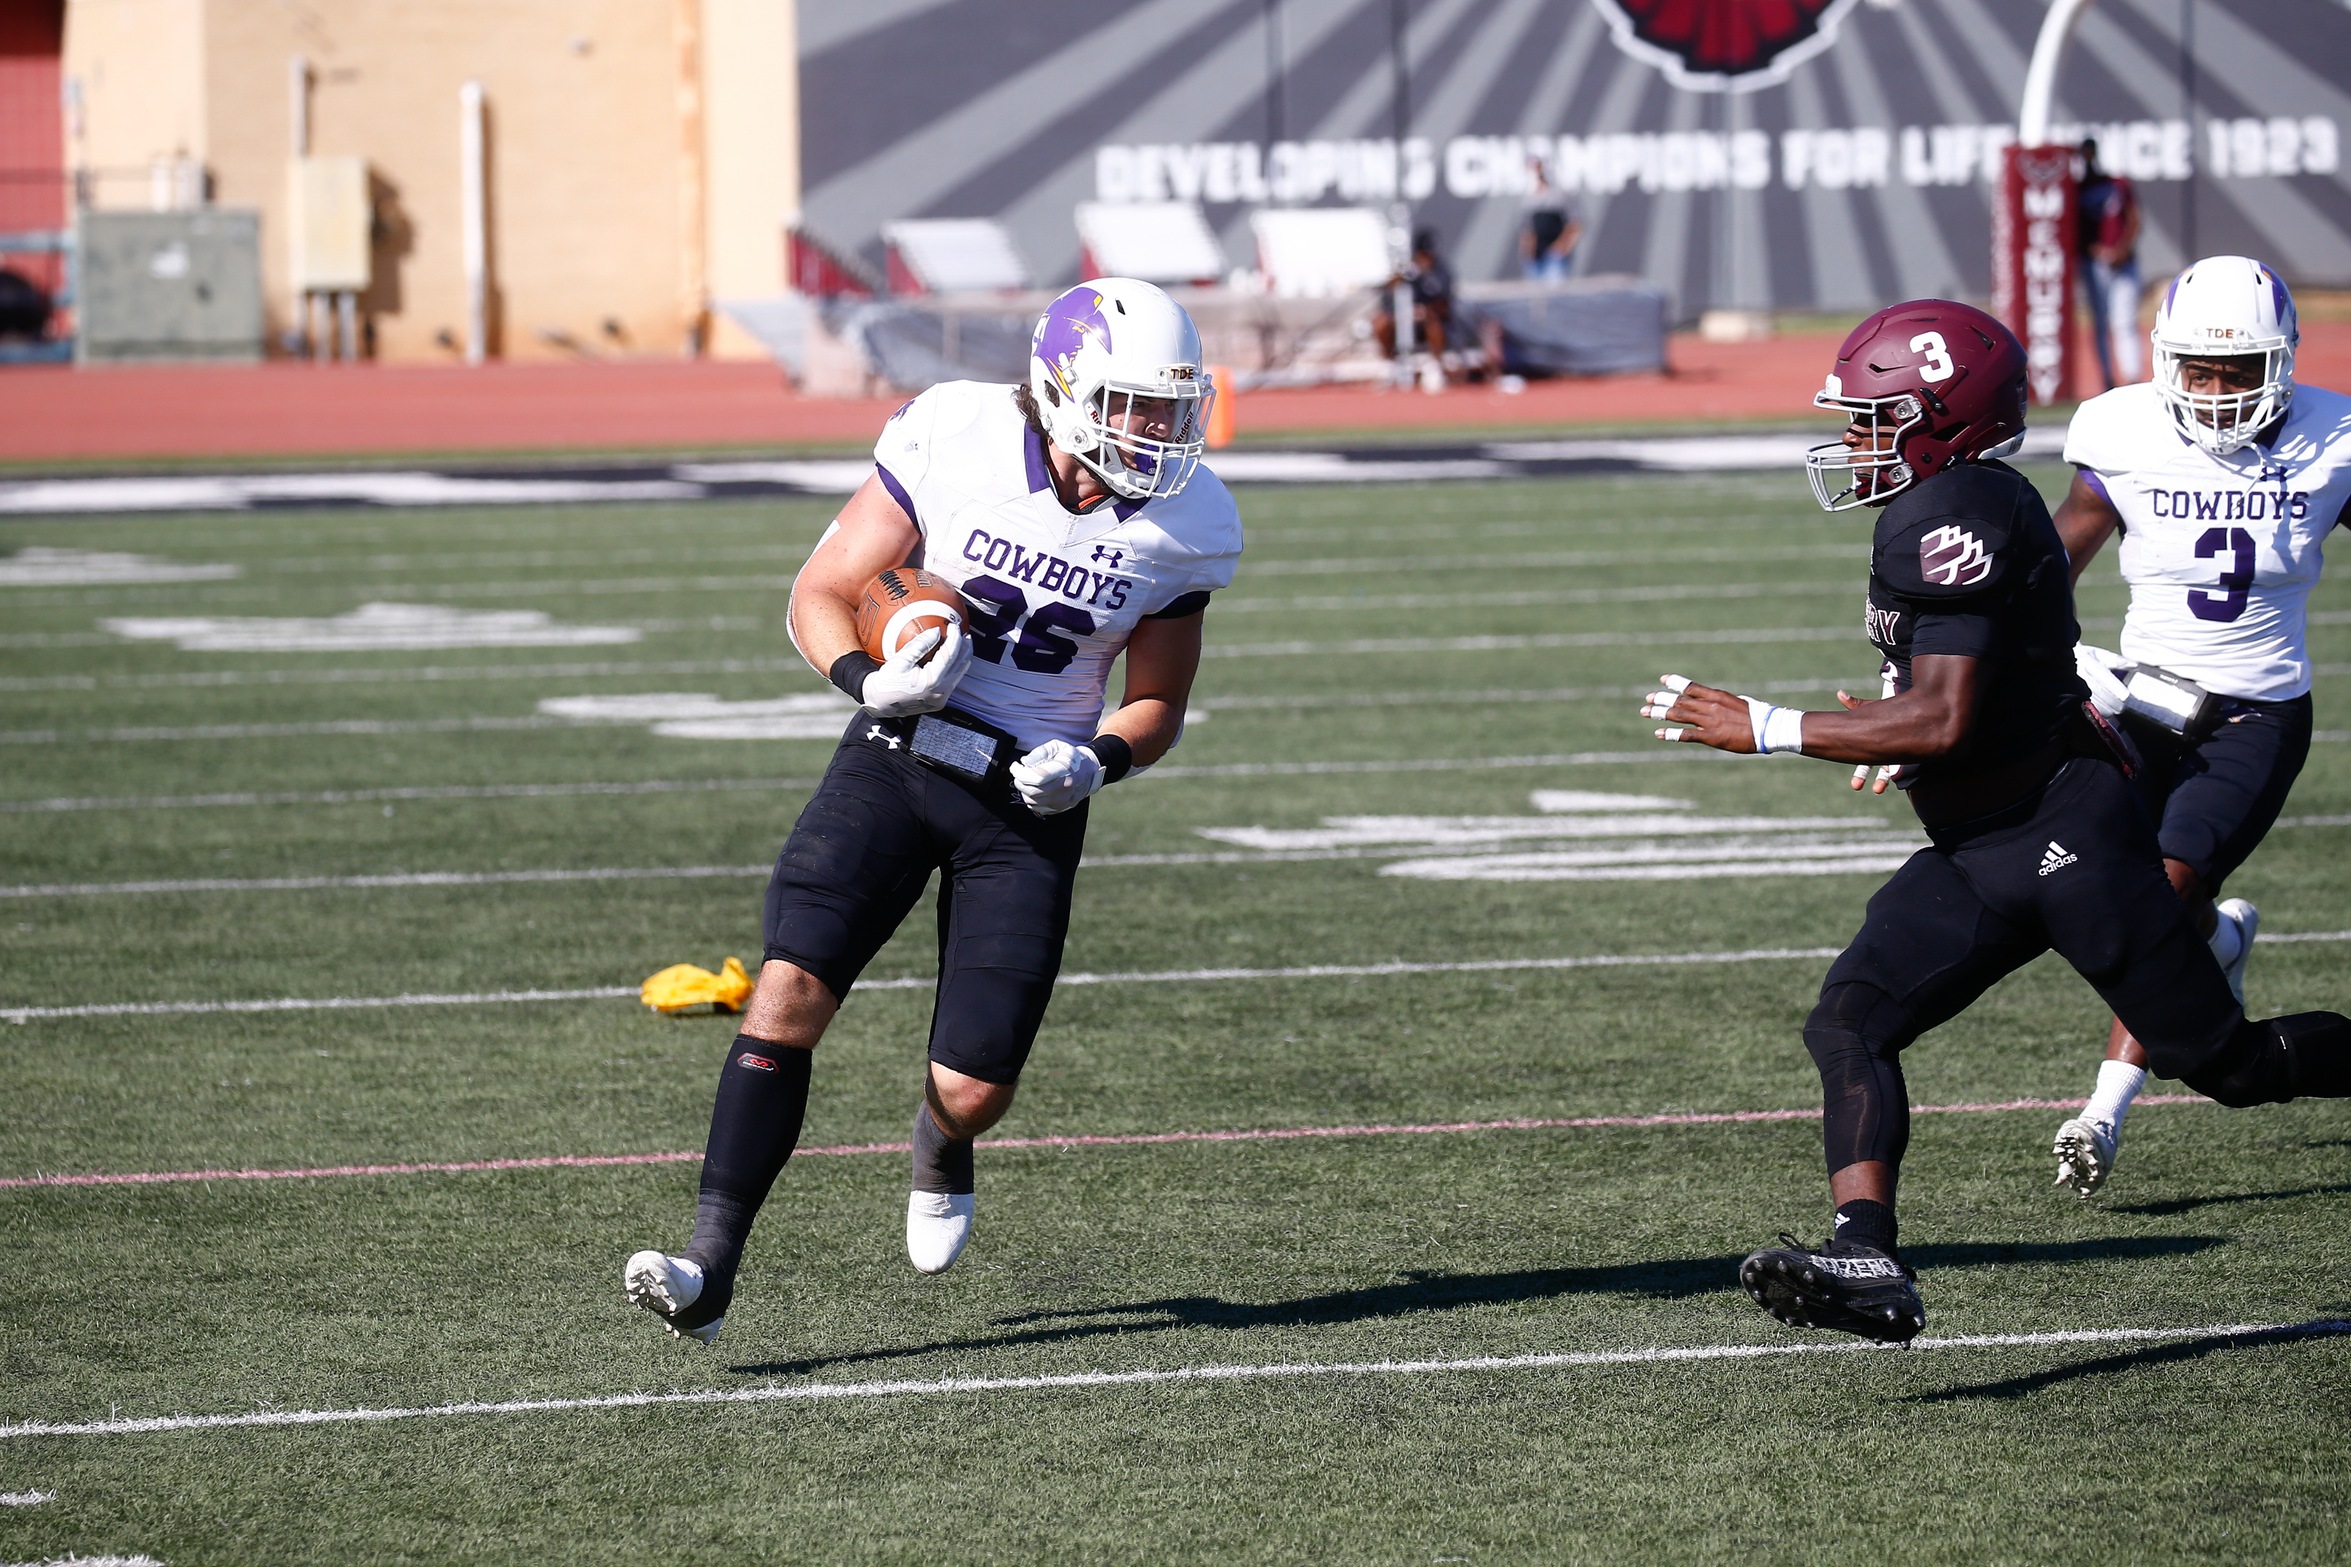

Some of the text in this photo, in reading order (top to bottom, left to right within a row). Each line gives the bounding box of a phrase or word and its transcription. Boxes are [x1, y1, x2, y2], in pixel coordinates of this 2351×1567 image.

[1780, 127, 1892, 188] FOR
[2207, 115, 2341, 179] 1923
[2206, 328, 2235, 339] TDE
[1170, 367, 1195, 380] TDE
[1909, 331, 1955, 384] 3
[2153, 489, 2310, 521] COWBOYS
[962, 528, 1133, 611] COWBOYS
[2186, 527, 2257, 623] 3
[2038, 853, 2078, 877] adidas
